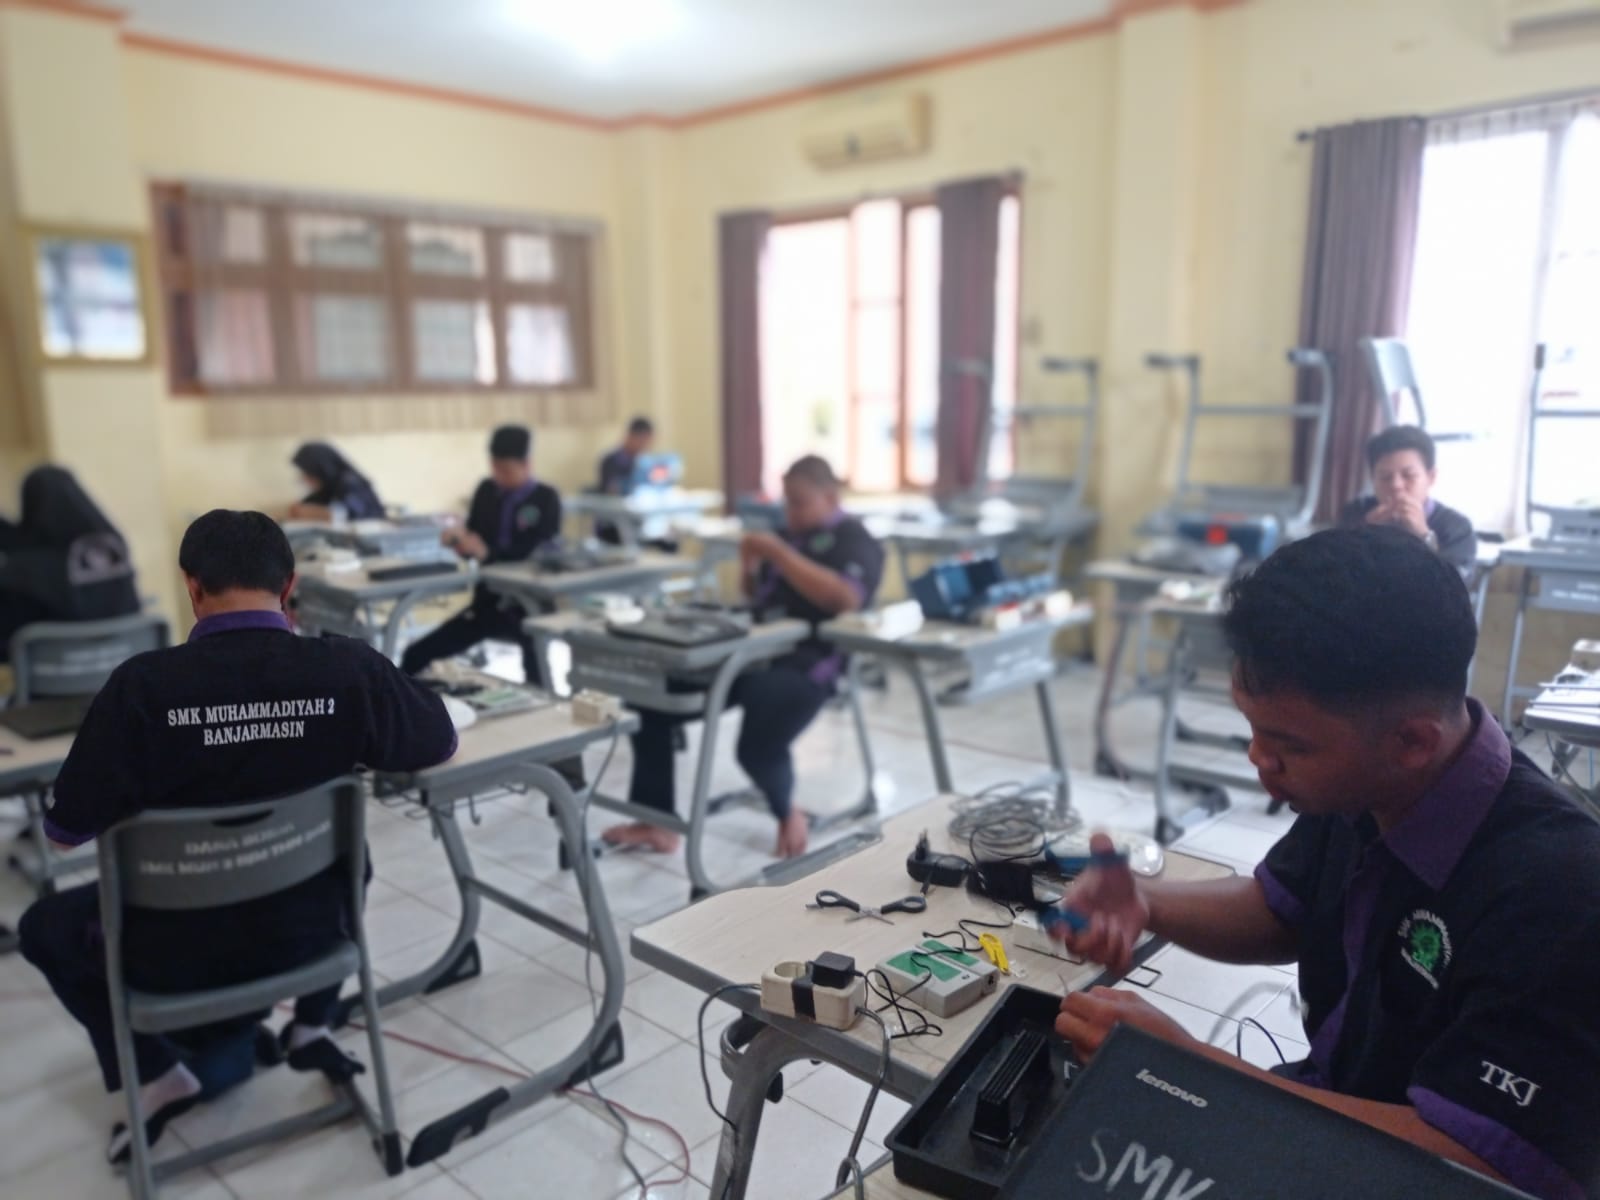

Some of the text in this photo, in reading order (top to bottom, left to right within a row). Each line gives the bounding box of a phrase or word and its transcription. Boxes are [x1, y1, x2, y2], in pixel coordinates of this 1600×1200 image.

[167, 697, 335, 727] SMK MUHAMMADIYAH 2
[203, 720, 304, 745] BANJARMASIN
[1135, 1068, 1208, 1108] lenovo
[1480, 1060, 1541, 1107] TKJ
